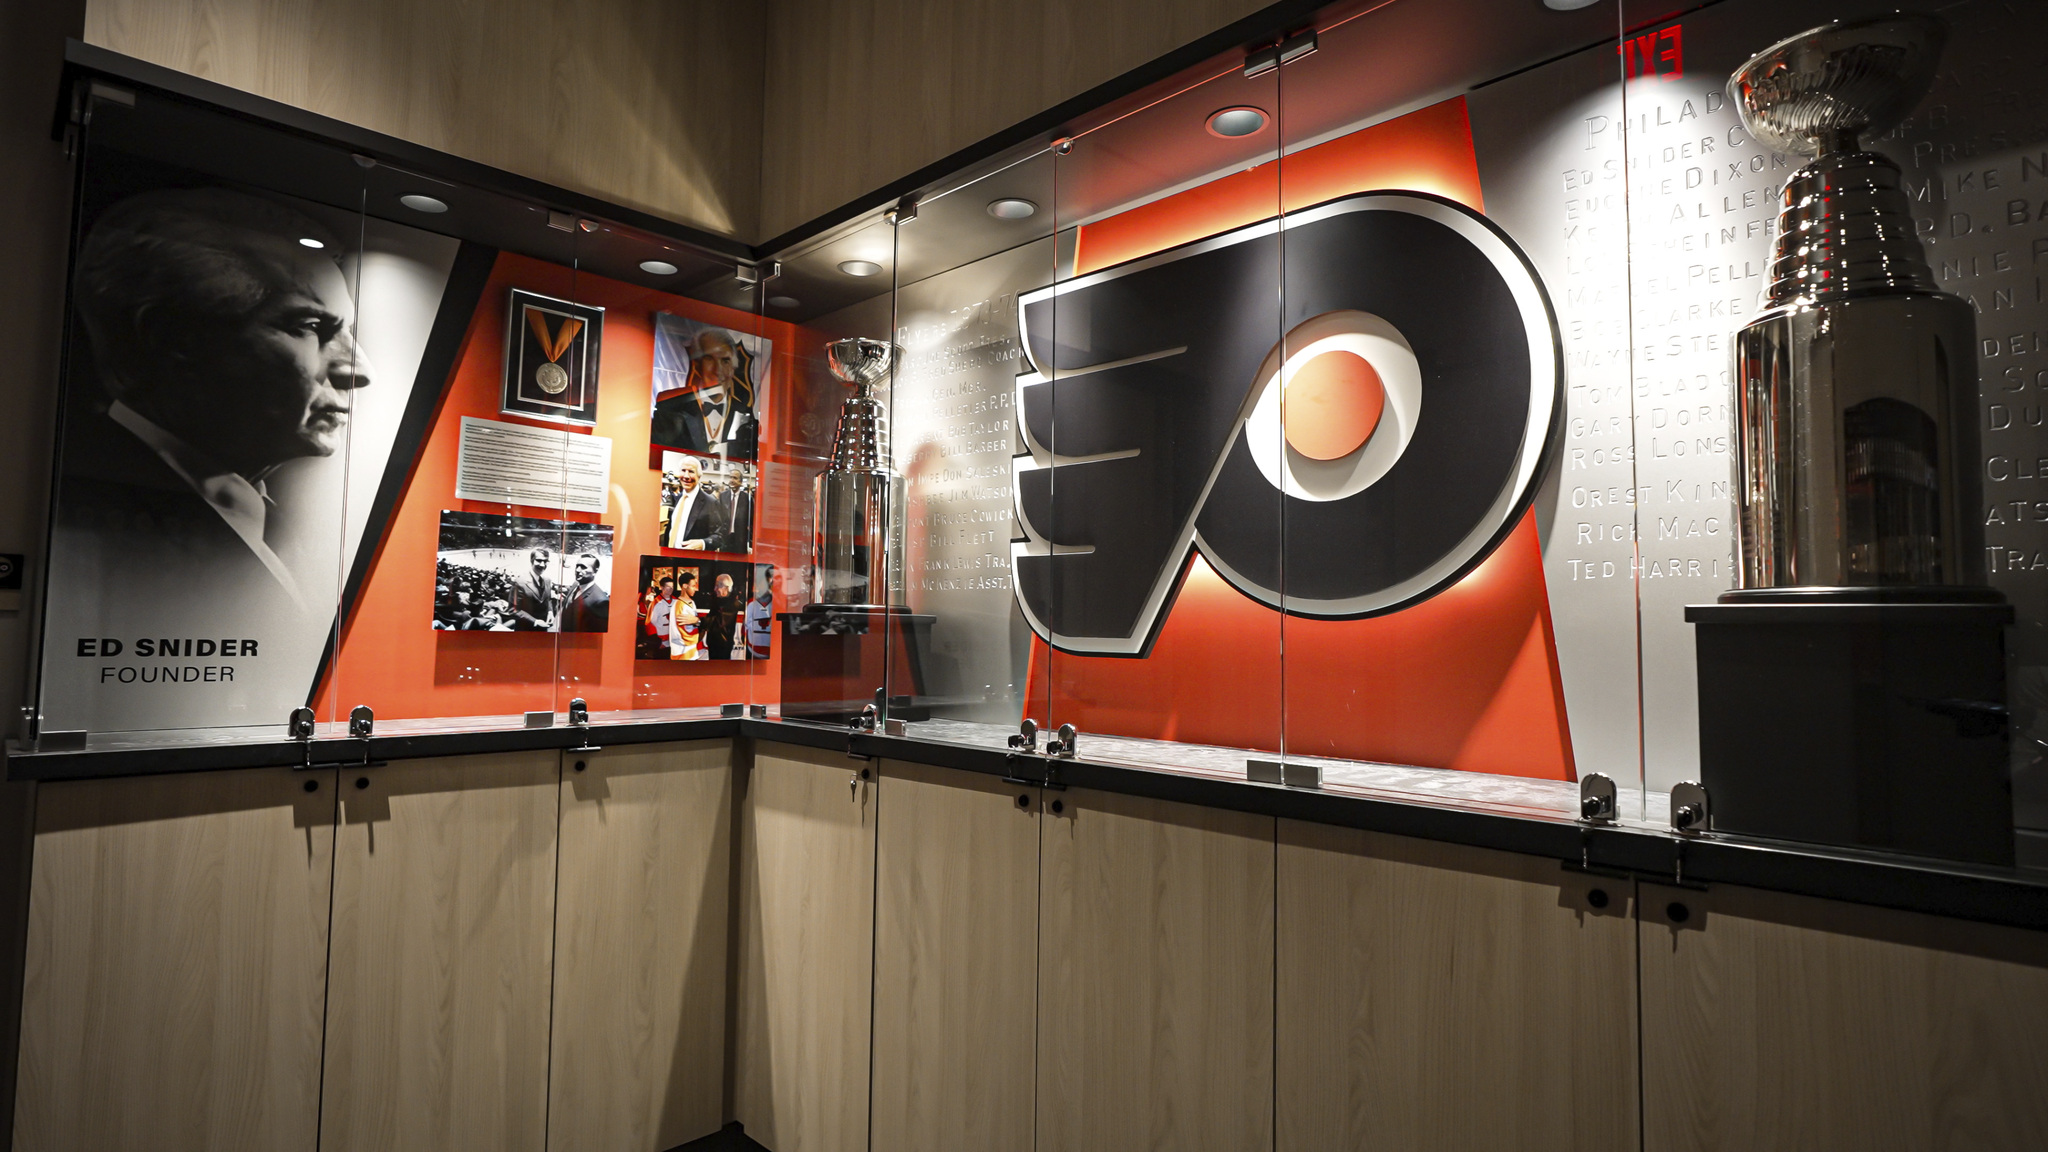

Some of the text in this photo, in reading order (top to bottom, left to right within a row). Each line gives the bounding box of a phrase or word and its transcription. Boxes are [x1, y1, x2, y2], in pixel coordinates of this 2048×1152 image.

[1562, 169, 1594, 193] ED
[1603, 136, 1715, 180] SNIDER
[1685, 154, 1787, 190] DIXON
[1669, 185, 1779, 224] ALLEN
[897, 322, 948, 346] FLYERS
[1573, 385, 1623, 408] TOM
[1570, 416, 1641, 439] GARY
[1571, 446, 1636, 471] ROSS
[942, 468, 962, 482] DON
[947, 488, 969, 504] JIM
[1571, 486, 1653, 509] OREST
[930, 532, 956, 548] BILL
[959, 528, 995, 545] FLETT
[1577, 522, 1643, 546] RICK
[1567, 559, 1616, 581] TED
[77, 638, 259, 657] ED SNIDER
[101, 666, 235, 684] FOUNDER
